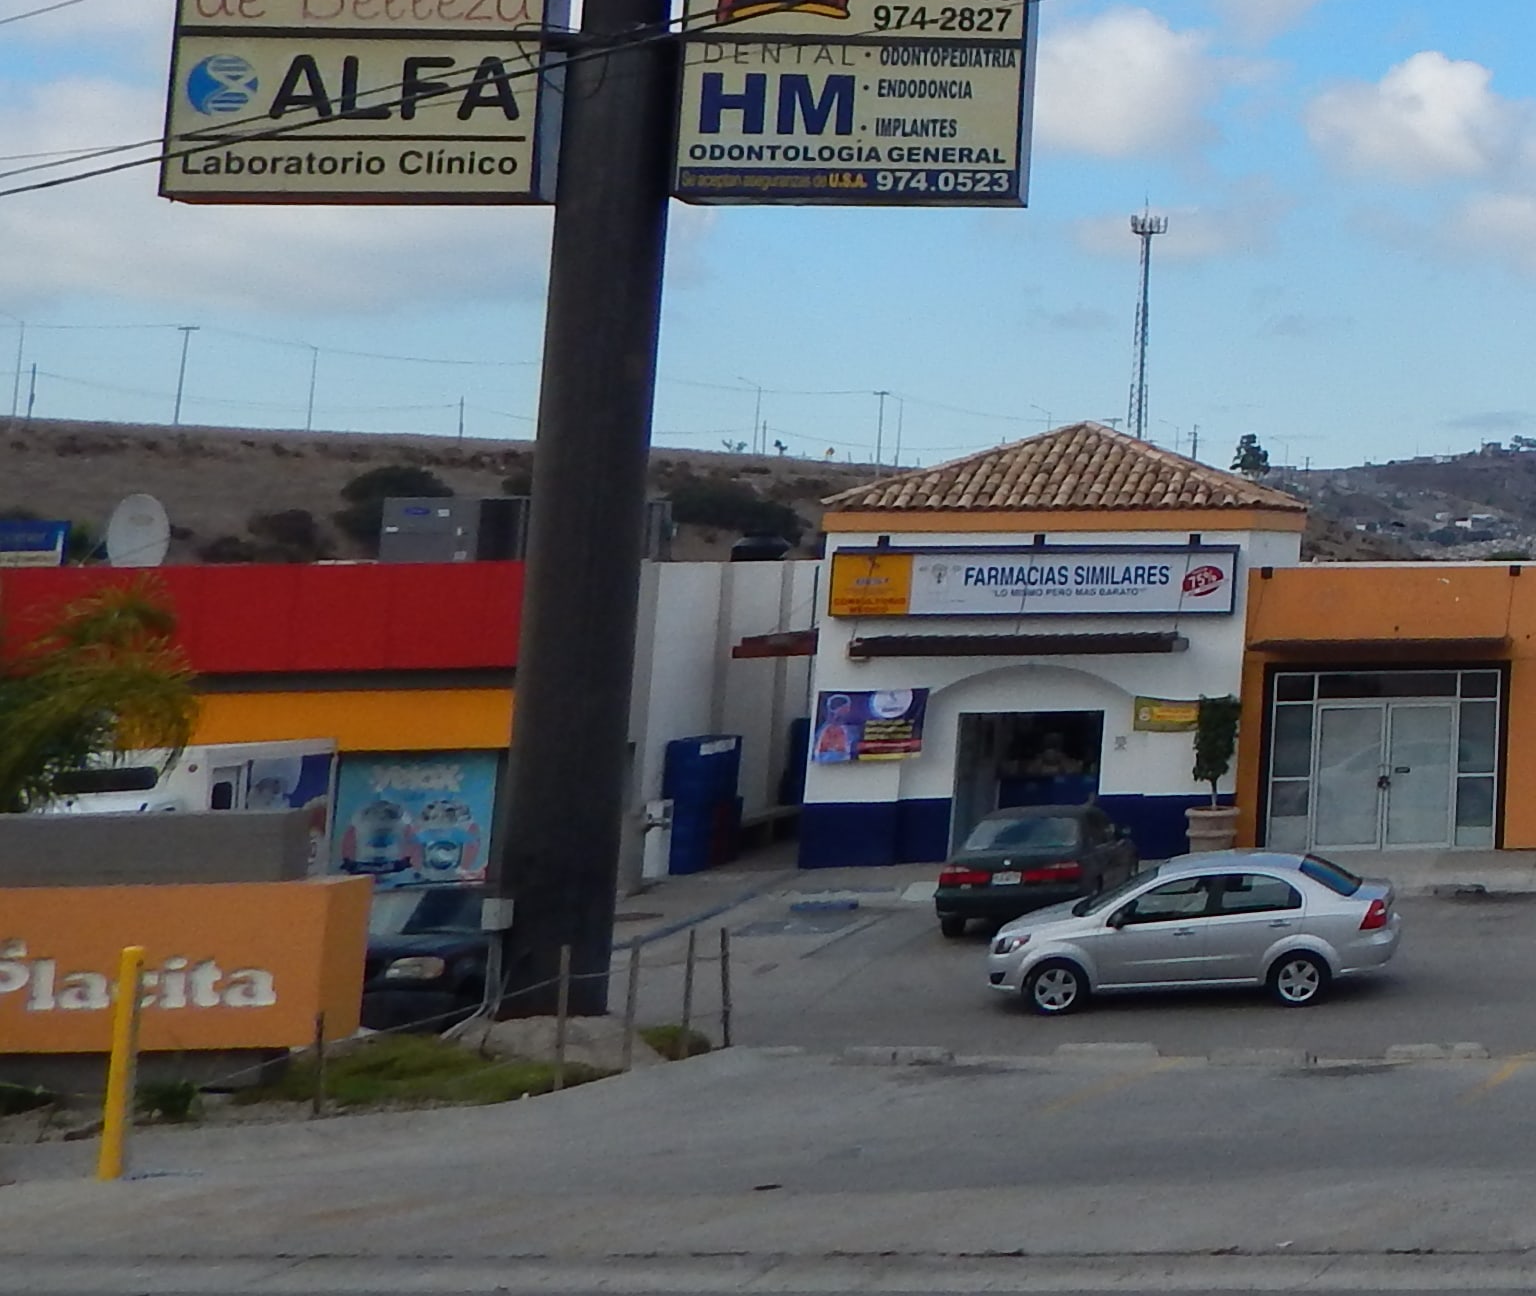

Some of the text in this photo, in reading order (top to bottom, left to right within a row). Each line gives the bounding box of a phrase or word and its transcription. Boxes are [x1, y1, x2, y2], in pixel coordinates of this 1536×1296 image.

[874, 5, 1012, 32] 974-2827
[703, 42, 1016, 68] DENTAL ODONTOPEDIATRIA
[269, 54, 519, 120] ALFA
[877, 79, 973, 100] ENDODONCIA
[698, 72, 856, 135] HM
[875, 117, 957, 138] IMPLANTES
[182, 149, 518, 175] Laboratorio Clínico
[887, 146, 1006, 164] GENERAL
[876, 171, 1010, 193] 974.0523
[964, 565, 1171, 586] FARMACIAS SIMILARES
[0, 958, 277, 1012] laita
